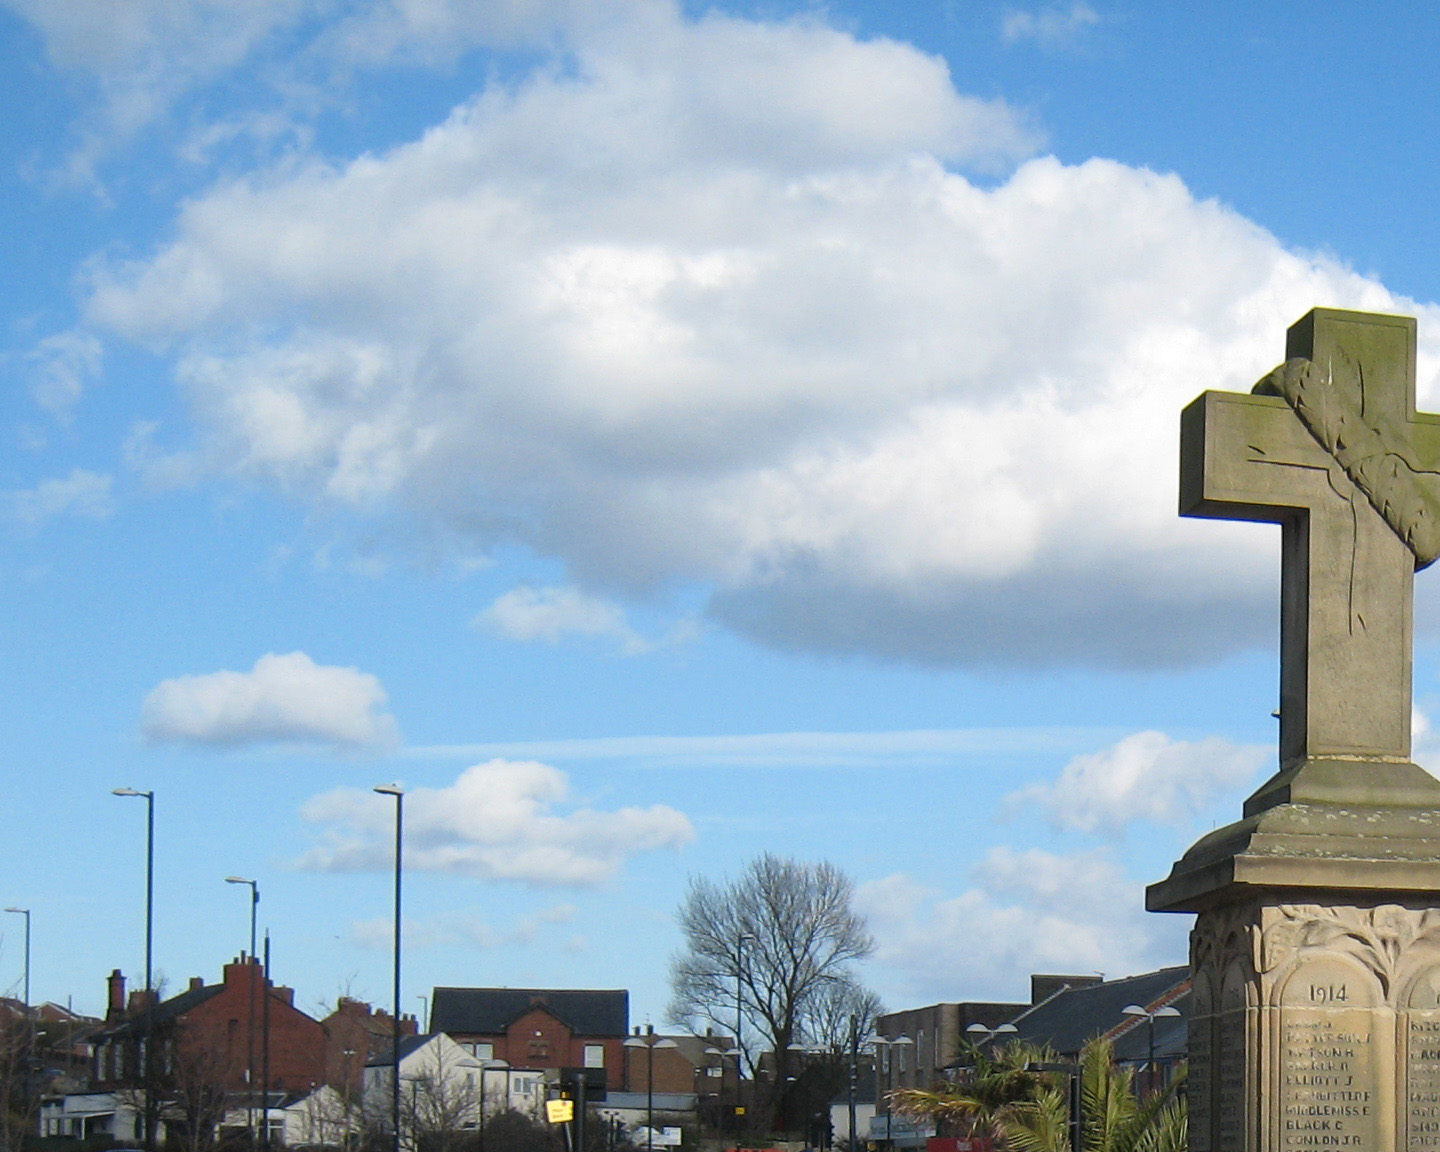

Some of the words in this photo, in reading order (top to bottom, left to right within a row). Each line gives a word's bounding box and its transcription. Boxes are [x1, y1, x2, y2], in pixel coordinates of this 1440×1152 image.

[1309, 983, 1349, 1005] 1914
[1285, 1119, 1331, 1131] BLACK
[1285, 1135, 1340, 1146] CONLON
